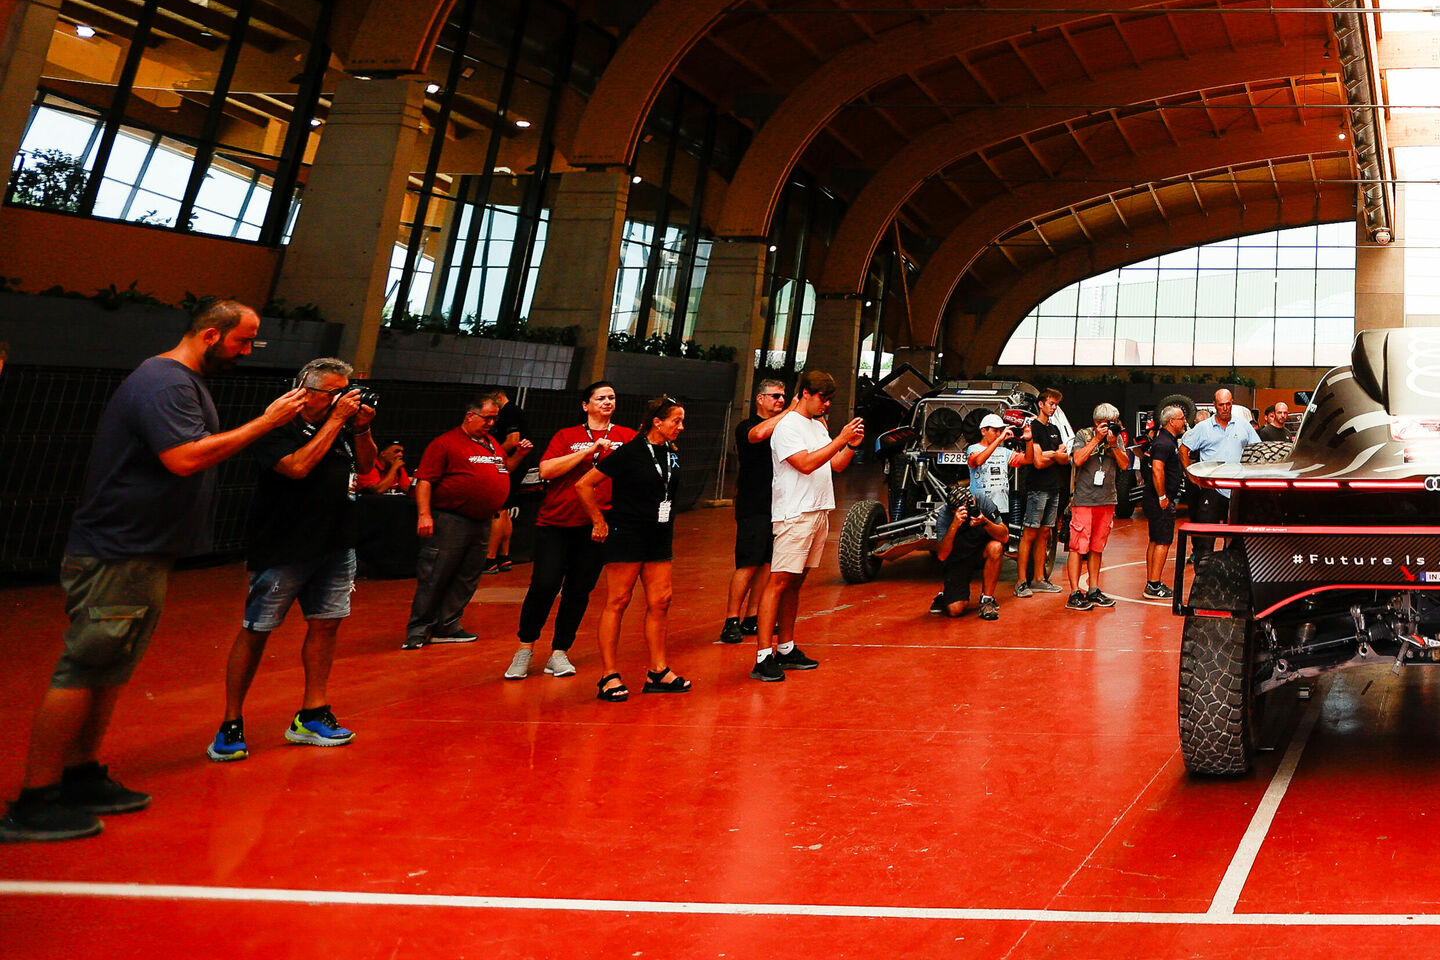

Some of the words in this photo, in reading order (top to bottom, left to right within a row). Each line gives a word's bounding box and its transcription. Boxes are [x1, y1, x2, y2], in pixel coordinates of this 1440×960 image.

[944, 453, 967, 462] 6289
[1292, 553, 1393, 566] #Future
[1405, 554, 1426, 565] Is
